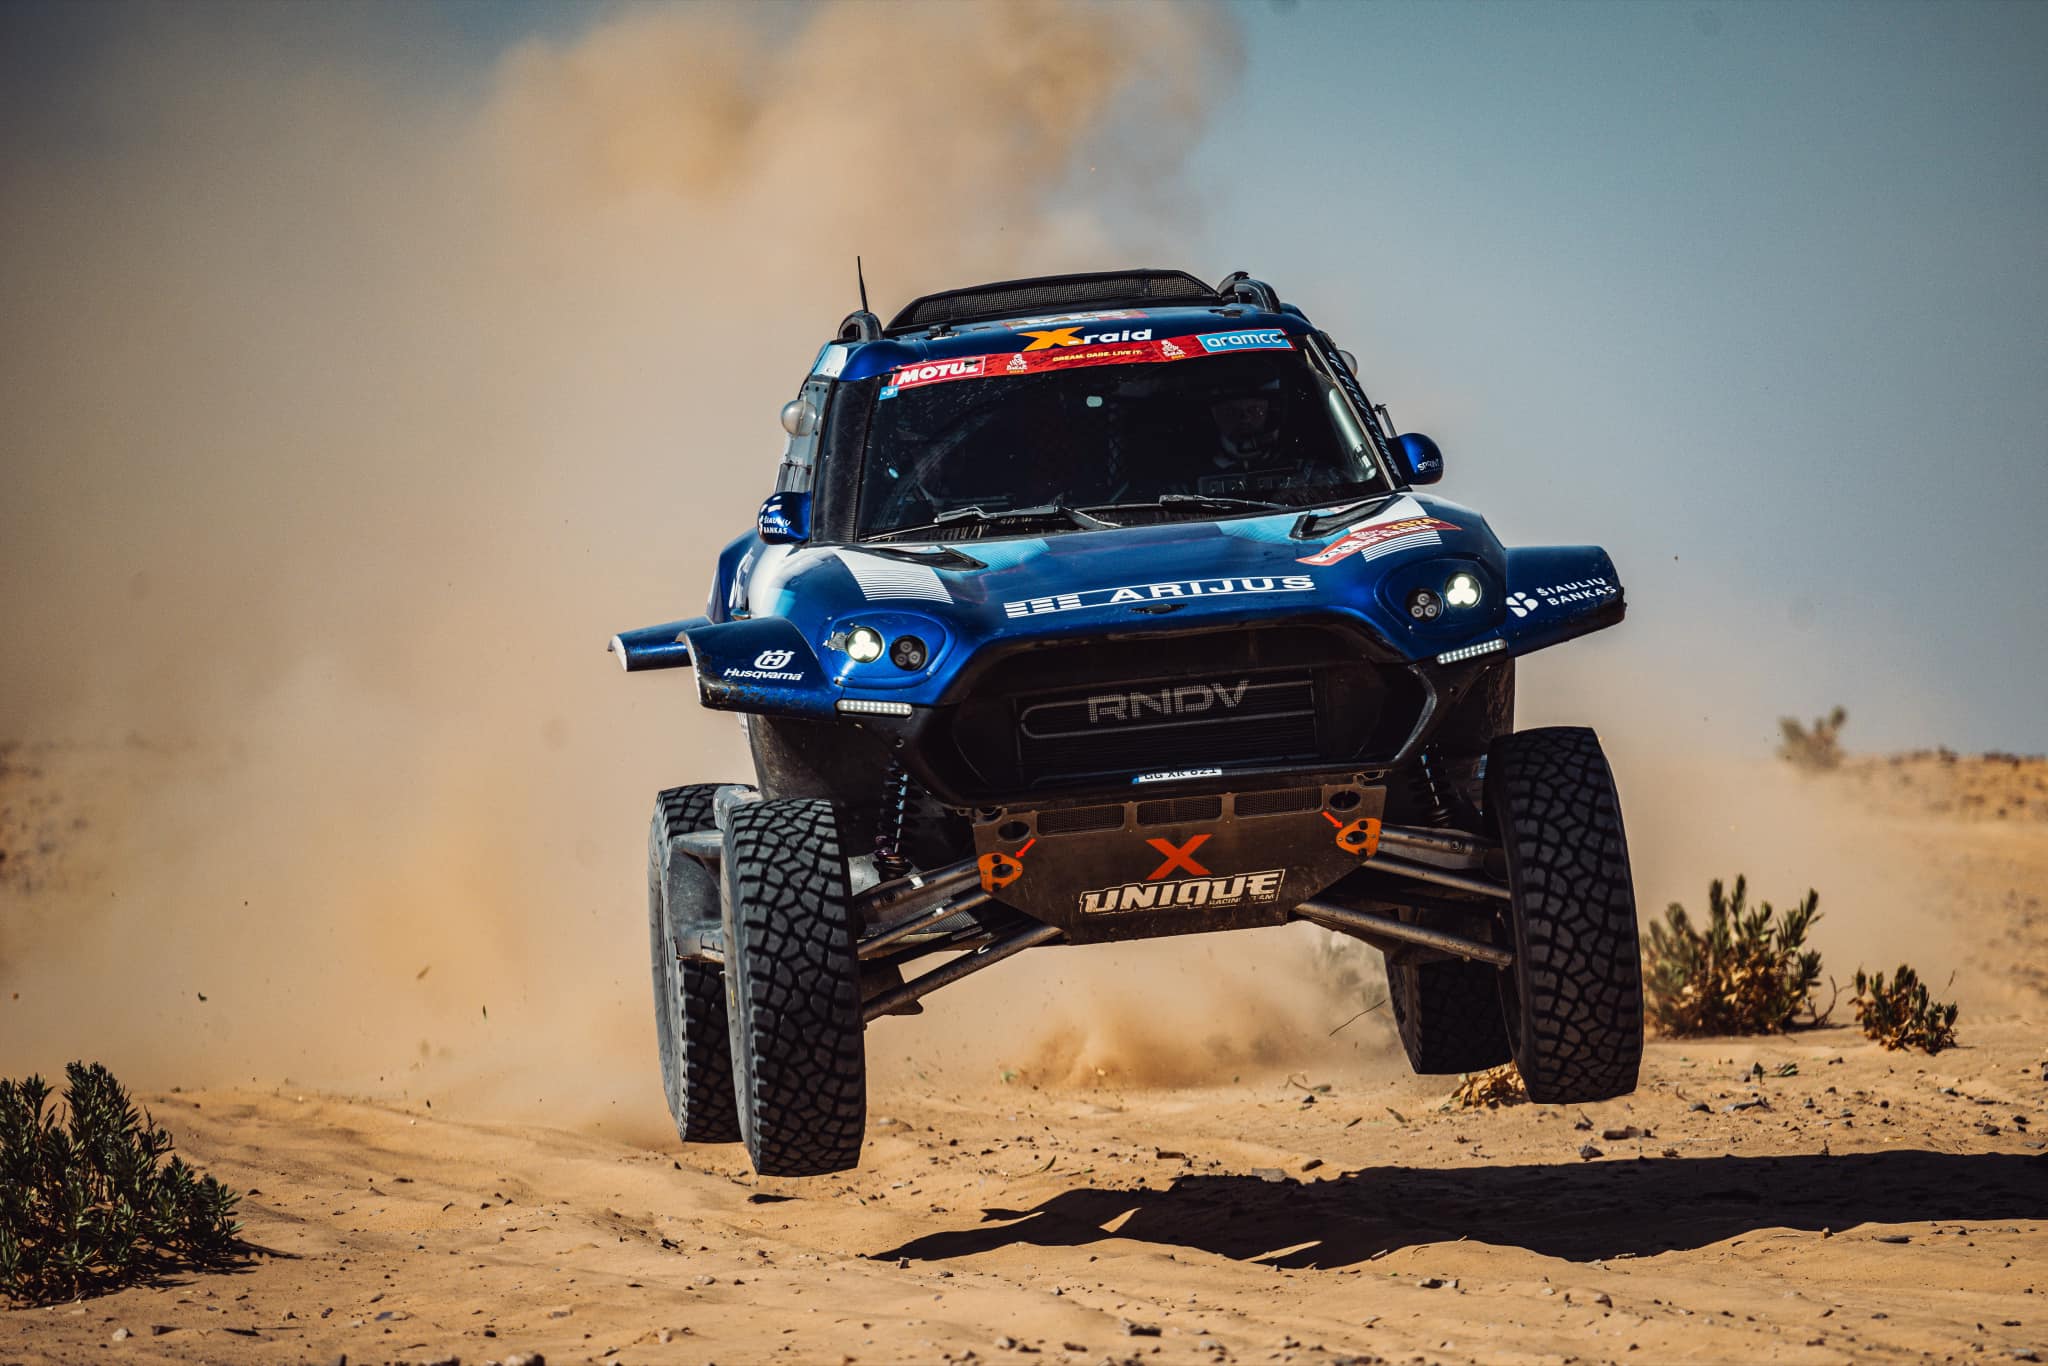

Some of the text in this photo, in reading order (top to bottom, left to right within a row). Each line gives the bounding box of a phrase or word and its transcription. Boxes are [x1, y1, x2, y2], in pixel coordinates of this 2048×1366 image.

[1109, 576, 1316, 603] ARIJUS
[1546, 585, 1617, 606] BANKAS
[723, 667, 805, 681] Husqvarna
[1087, 679, 1250, 724] RNDV
[1145, 834, 1213, 881] X
[1083, 872, 1281, 914] UNIQUE
